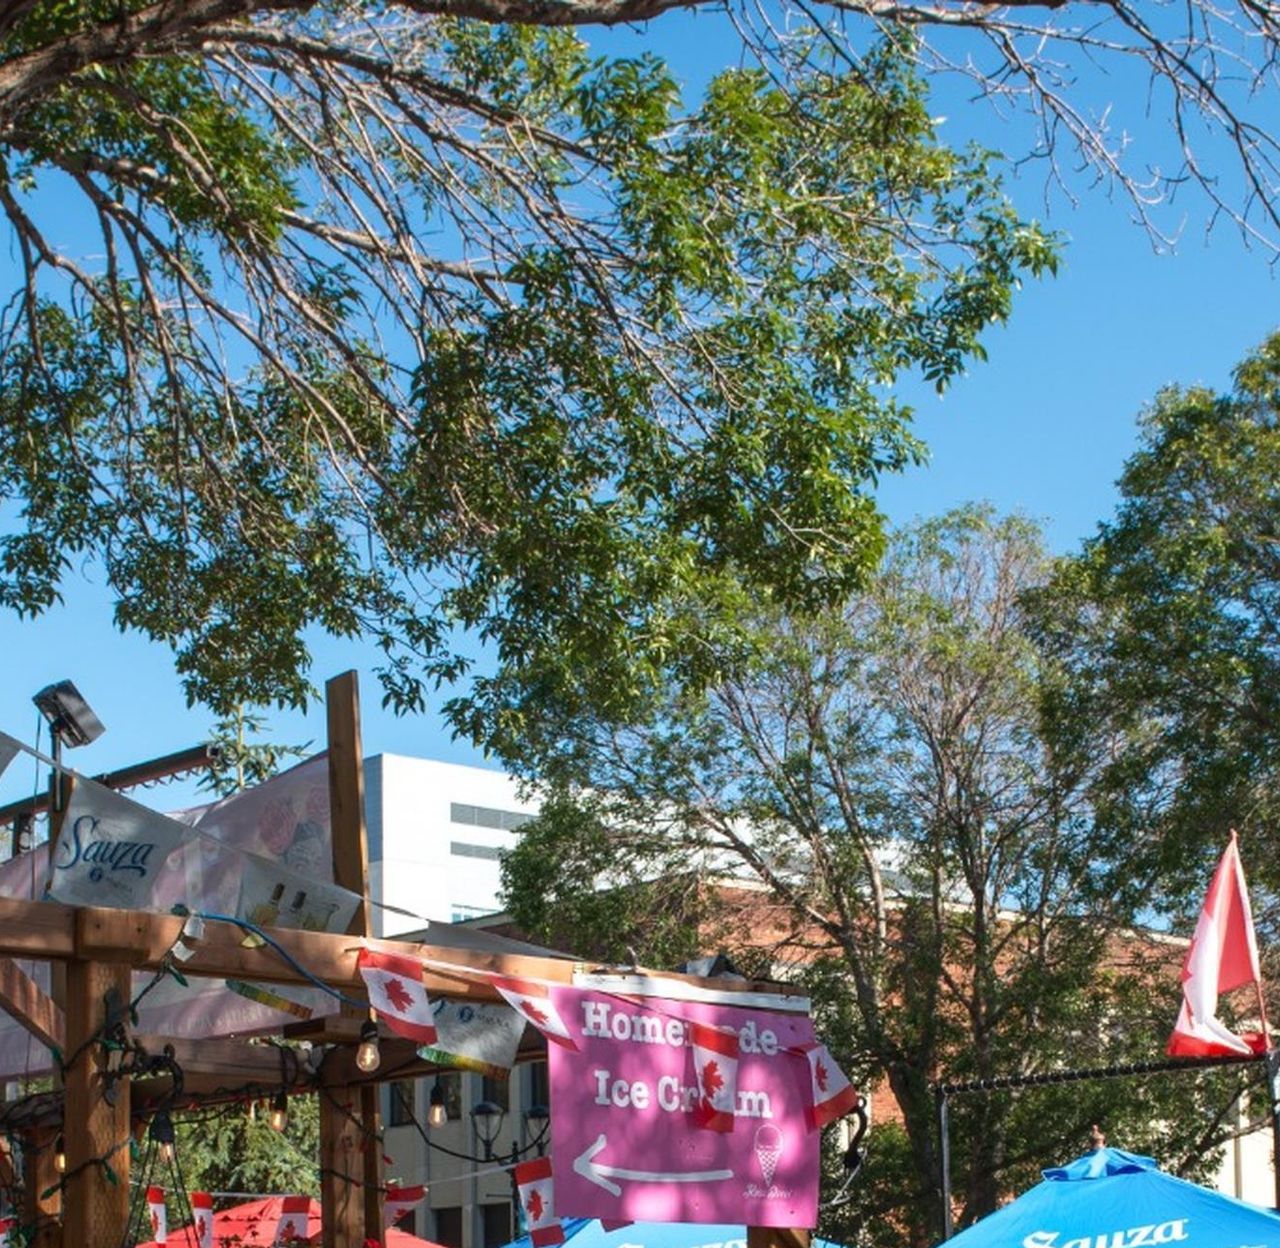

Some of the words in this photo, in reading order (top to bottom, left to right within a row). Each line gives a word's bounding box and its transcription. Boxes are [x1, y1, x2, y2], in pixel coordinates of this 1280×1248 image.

[56, 815, 155, 878] Sauza
[581, 1001, 778, 1056] Homede
[594, 1069, 650, 1109] Ice
[657, 1076, 773, 1119] Crm
